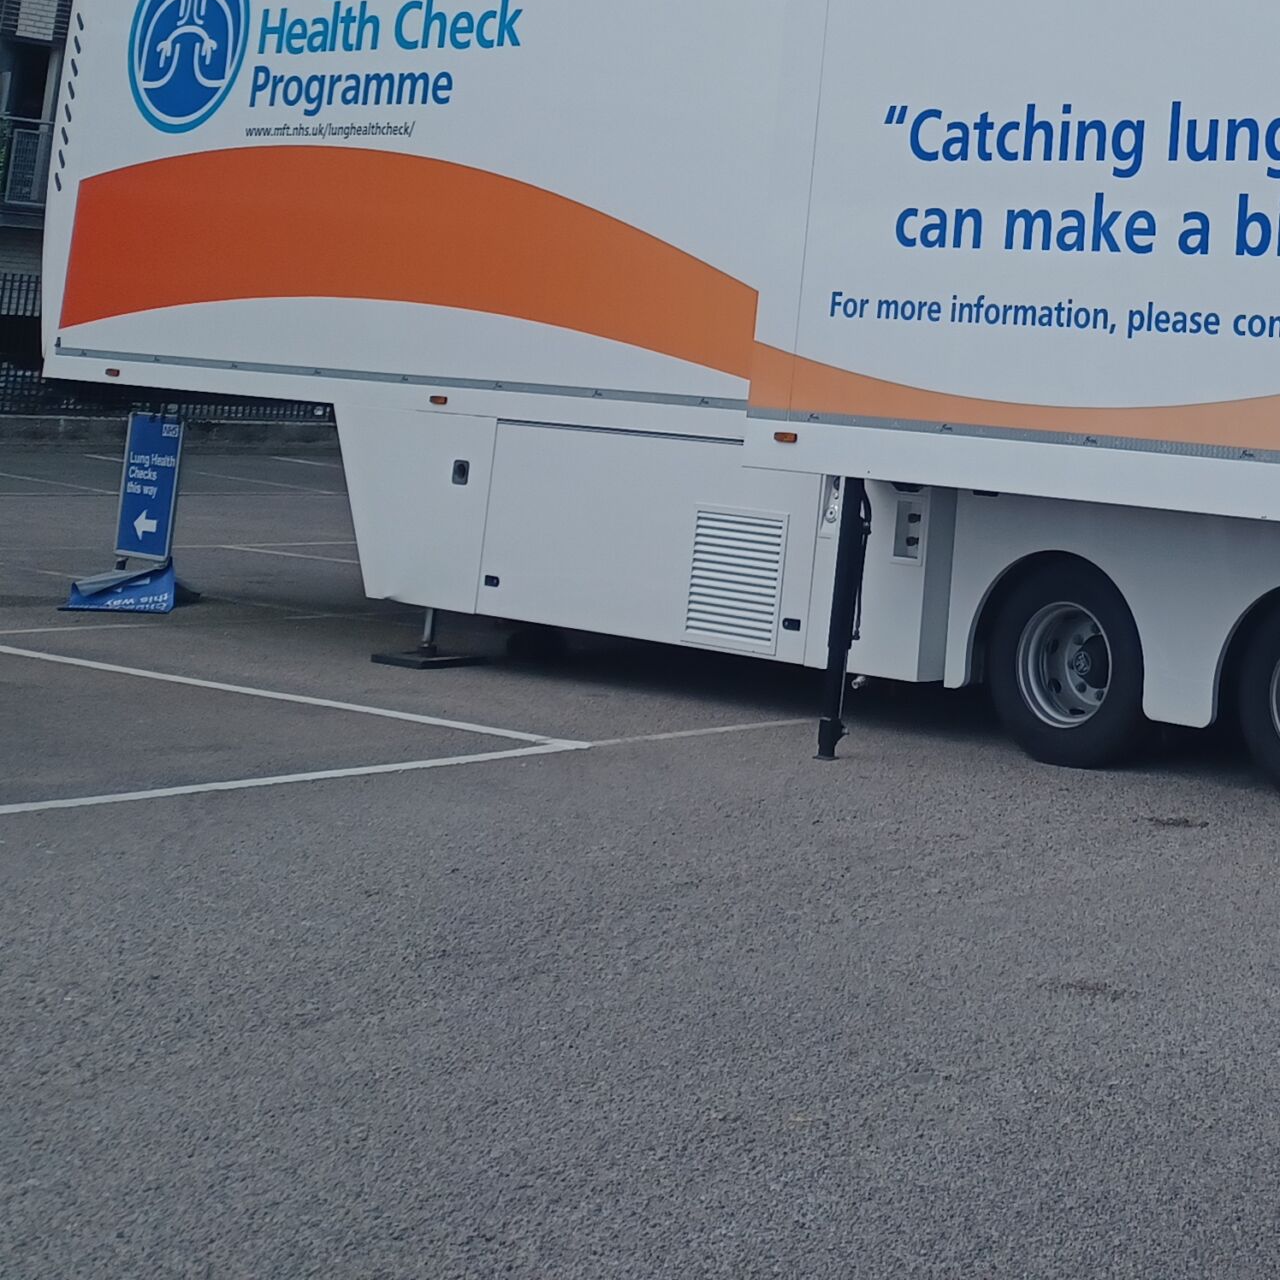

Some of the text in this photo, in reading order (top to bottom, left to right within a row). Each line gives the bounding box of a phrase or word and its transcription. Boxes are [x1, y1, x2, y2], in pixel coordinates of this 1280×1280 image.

[258, 0, 380, 55] Health
[249, 65, 453, 117] Programme
[246, 121, 415, 139] www.mft.nhs.uk/lunghealthcheck/
[896, 208, 982, 249] can
[1004, 192, 1156, 254] make
[1178, 211, 1210, 255] a
[830, 291, 869, 318] For
[877, 299, 941, 322] more
[951, 295, 1116, 334] information,
[1127, 302, 1220, 339] please
[128, 465, 158, 481] Checks
[130, 451, 176, 468] Lung Health
[126, 481, 158, 499] this way
